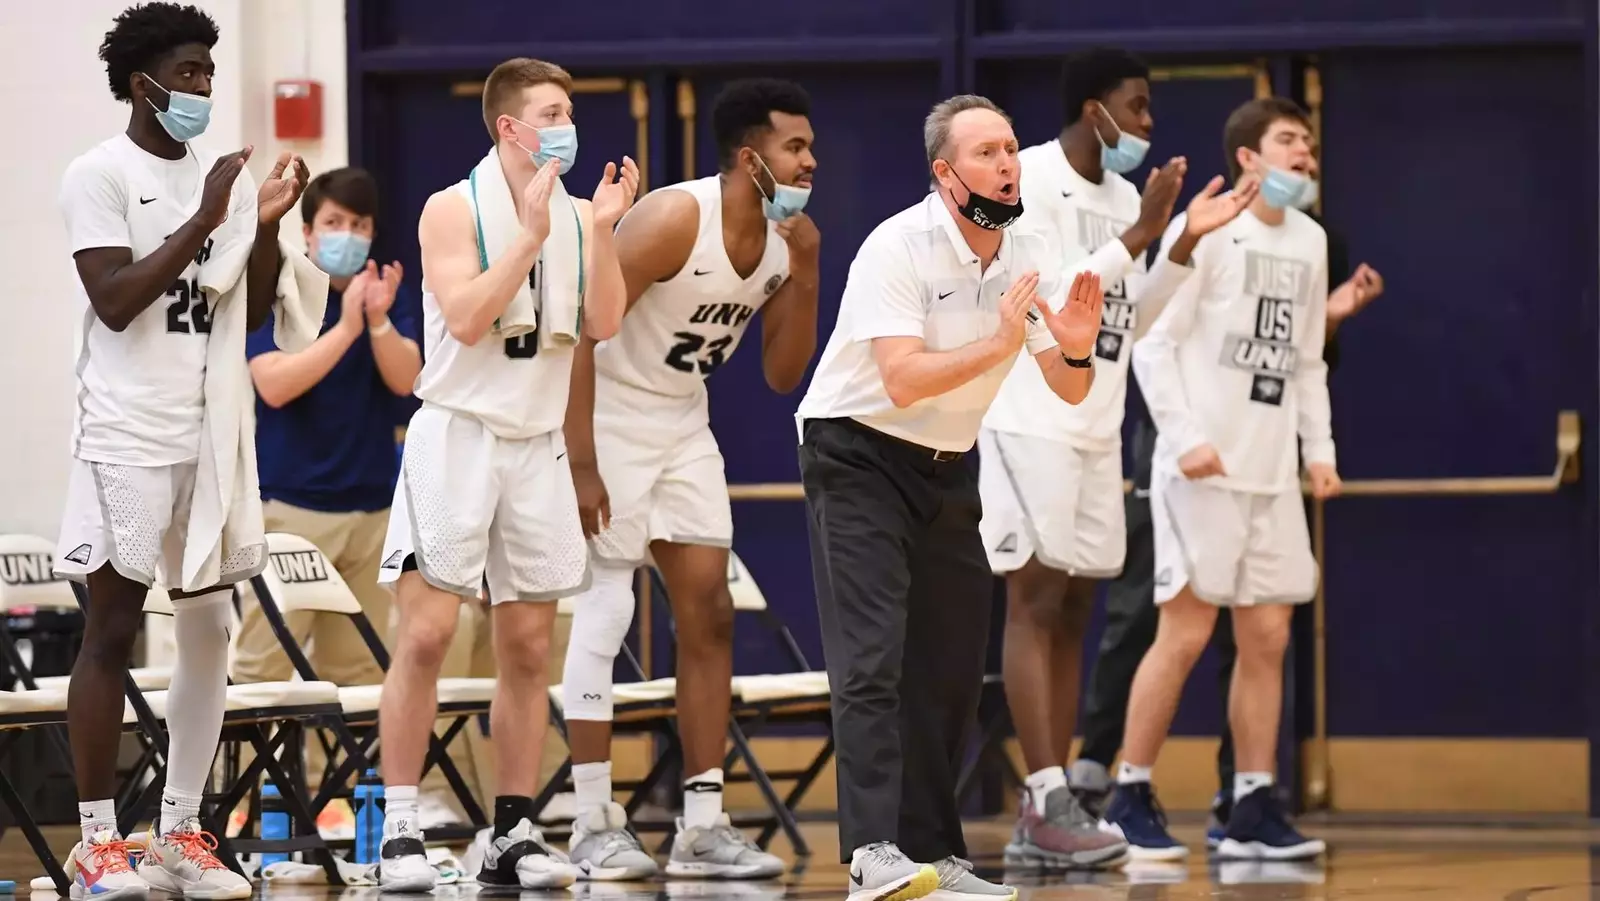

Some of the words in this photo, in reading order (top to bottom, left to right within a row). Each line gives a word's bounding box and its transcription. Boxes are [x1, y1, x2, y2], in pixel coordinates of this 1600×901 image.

[1250, 257, 1305, 299] JUST
[166, 279, 211, 334] 22
[689, 303, 754, 327] UNH
[1259, 298, 1292, 341] US
[665, 332, 734, 375] 23
[269, 550, 328, 584] UNH
